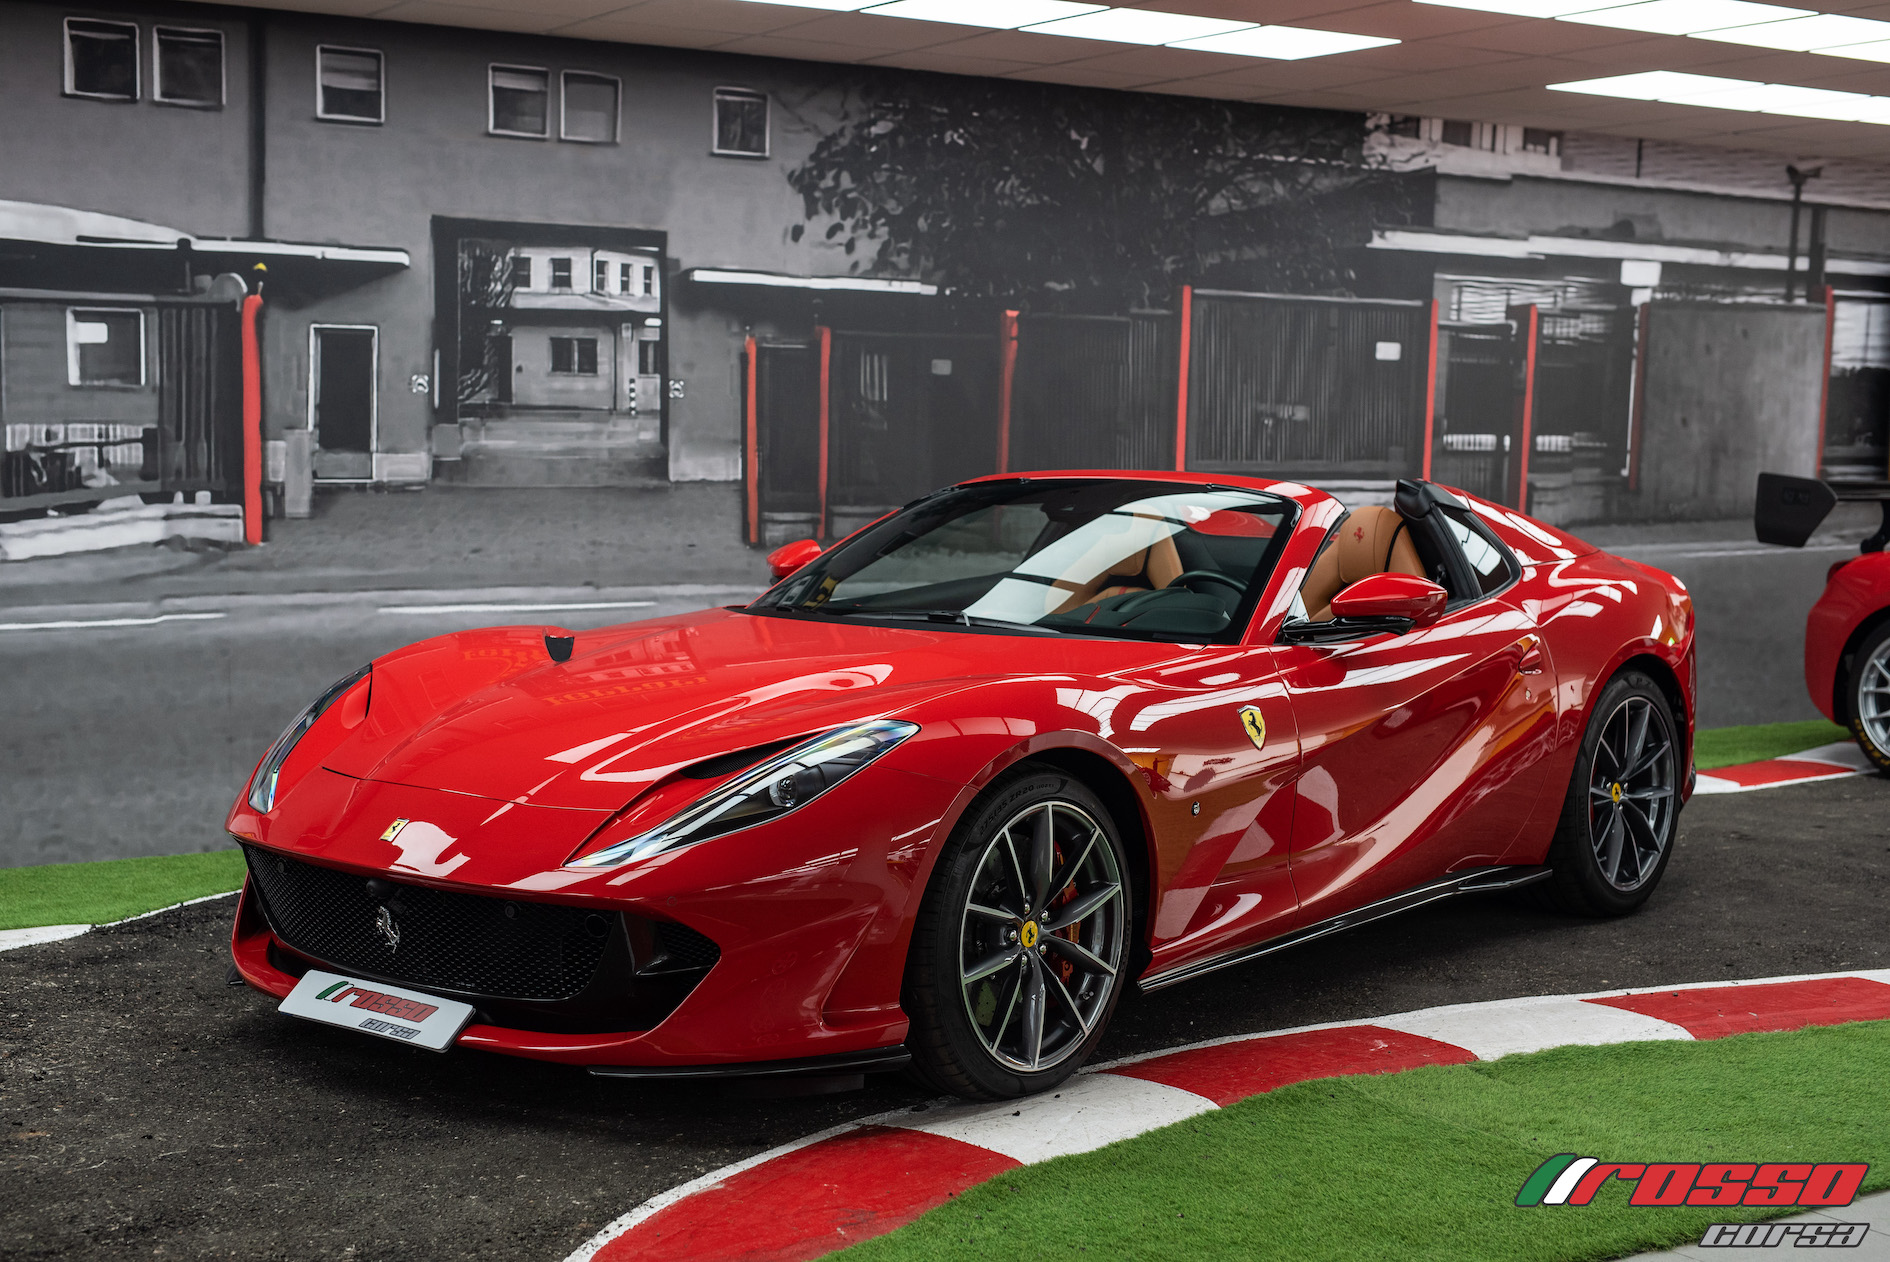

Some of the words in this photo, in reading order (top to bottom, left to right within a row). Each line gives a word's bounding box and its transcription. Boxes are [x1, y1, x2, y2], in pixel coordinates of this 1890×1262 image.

[1009, 784, 1035, 803] ZR20
[331, 987, 439, 1022] rosso
[358, 1017, 422, 1040] corsa
